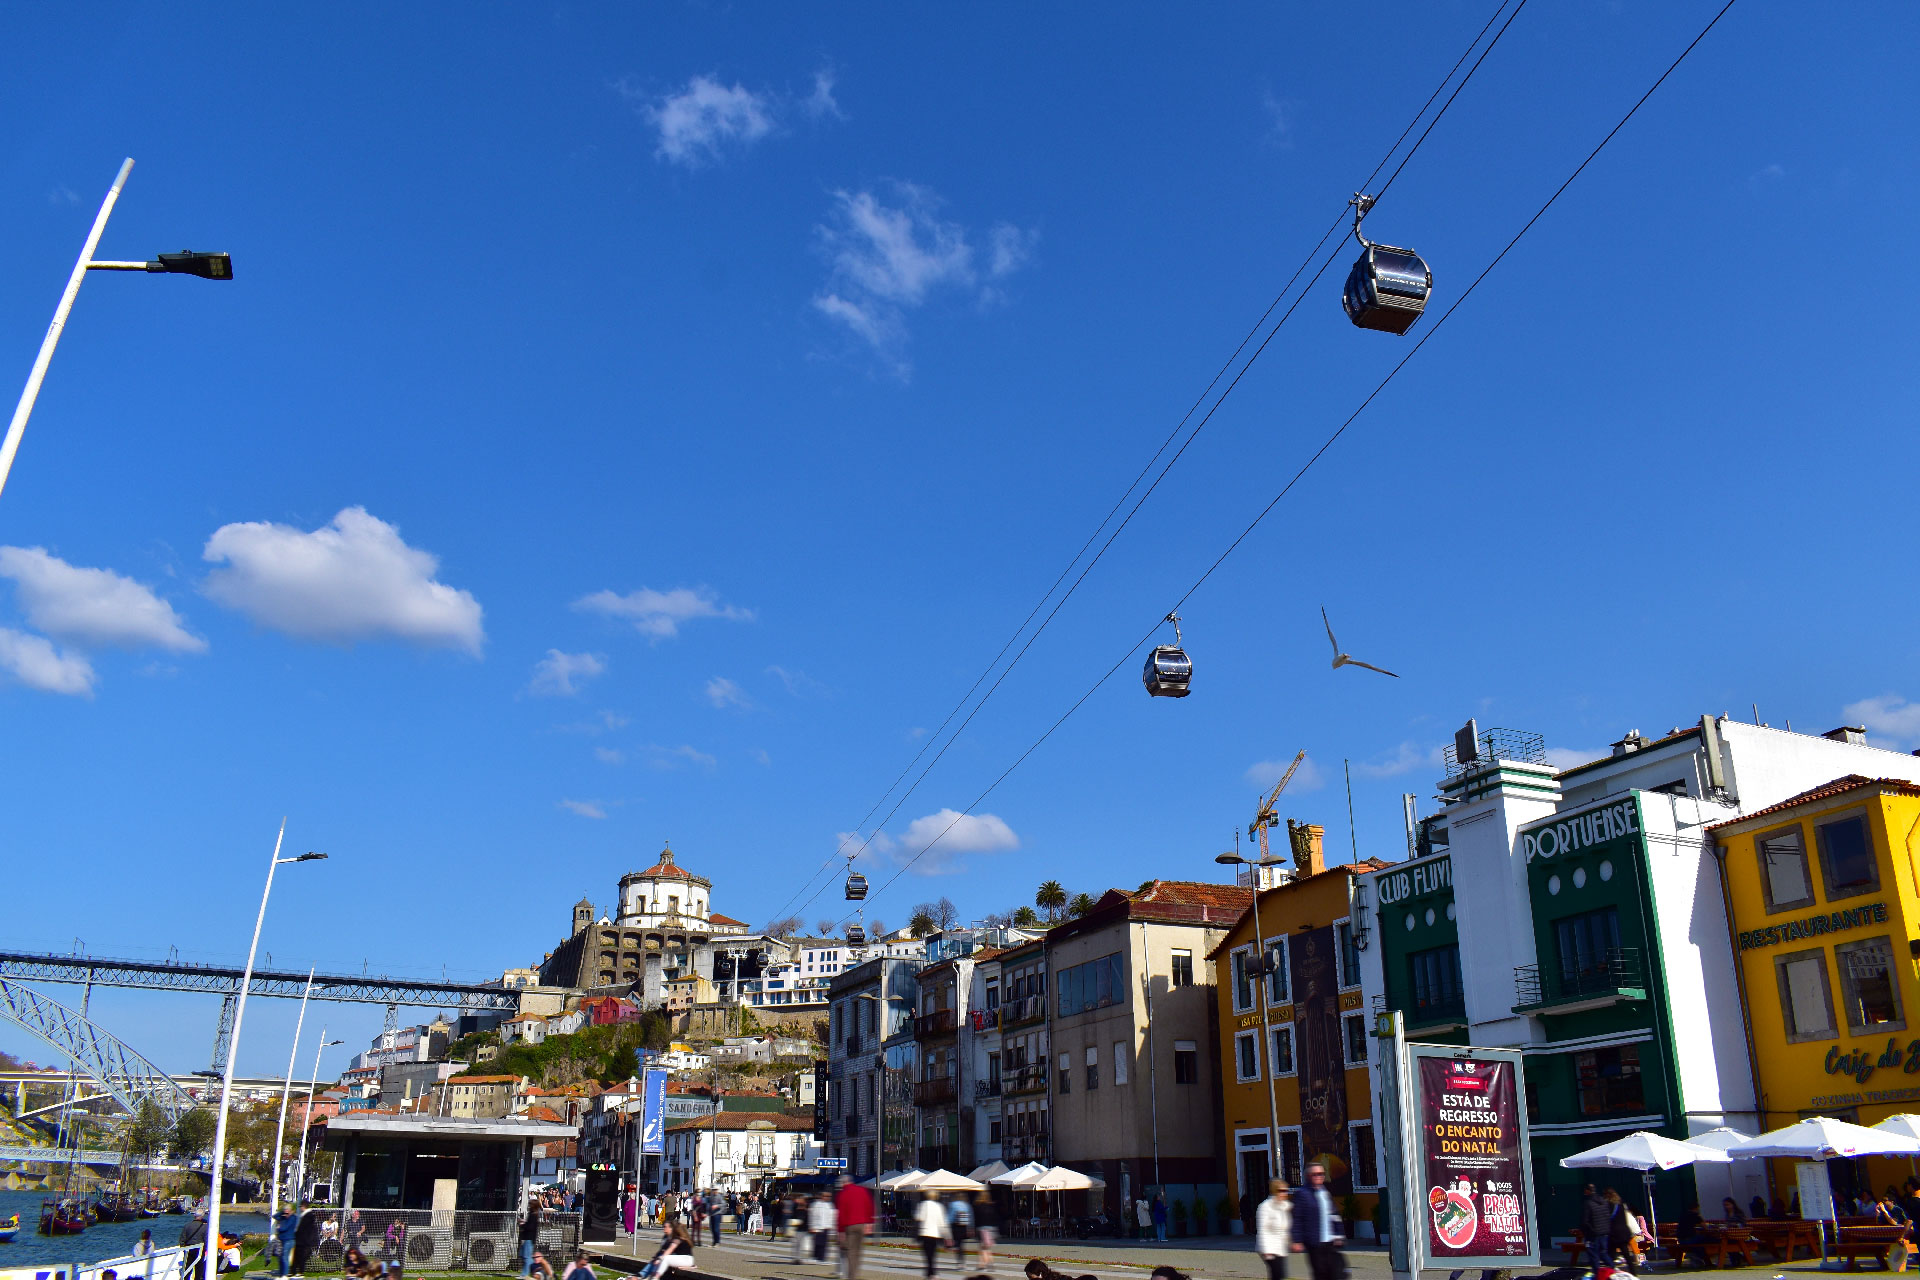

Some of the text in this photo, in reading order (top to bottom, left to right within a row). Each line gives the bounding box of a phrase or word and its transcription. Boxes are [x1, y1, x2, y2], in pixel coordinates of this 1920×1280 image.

[1378, 872, 1411, 905] CLUB
[1523, 800, 1638, 864] PORTUENSE
[1739, 902, 1889, 951] RESTAURANTE
[1825, 1045, 1874, 1084] Cais
[1877, 1038, 1903, 1068] do
[1442, 1091, 1491, 1108] ESTÁ DE
[1811, 1091, 1864, 1108] COZINHA
[1439, 1109, 1498, 1124] REGRESSO
[1435, 1125, 1502, 1139] O ENCANTO
[1441, 1140, 1501, 1154] DO NATAL
[591, 1163, 616, 1171] GAIA
[1490, 1215, 1522, 1233] NATAL
